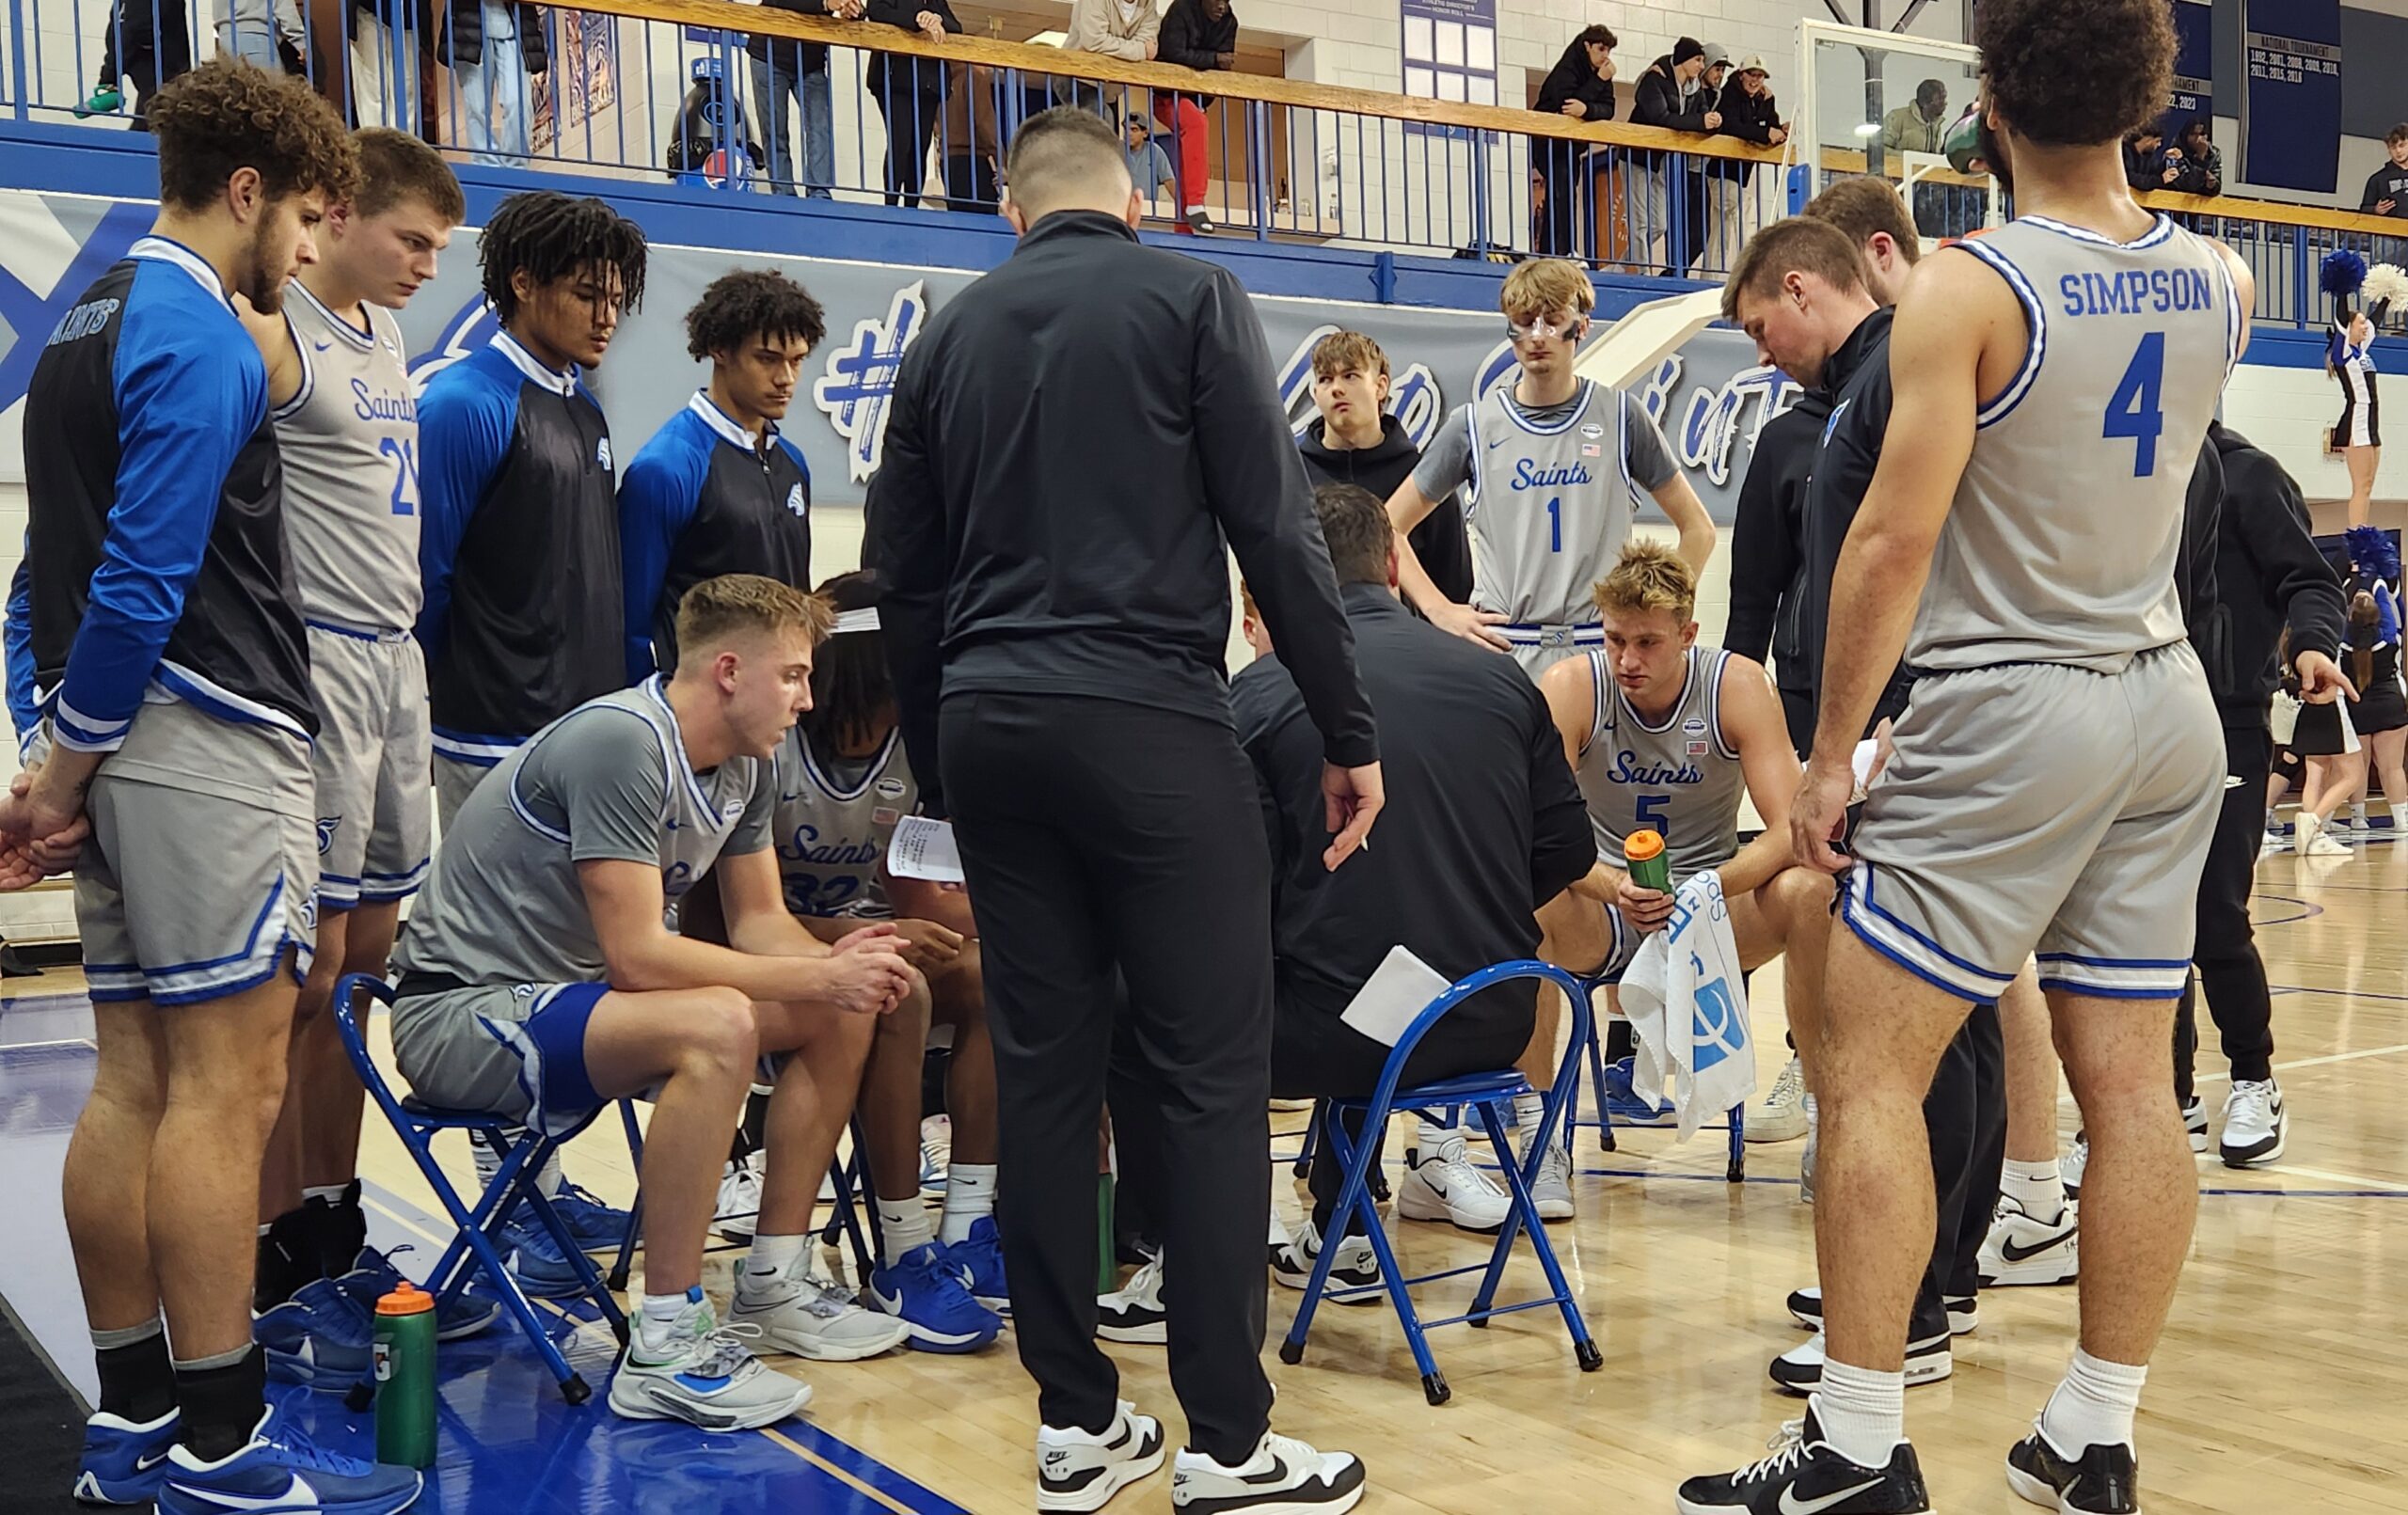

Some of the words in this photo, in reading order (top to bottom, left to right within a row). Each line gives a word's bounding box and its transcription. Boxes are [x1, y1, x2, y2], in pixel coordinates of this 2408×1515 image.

[2290, 40, 2330, 58] TOURNAMENT
[2059, 268, 2211, 317] SIMPSON
[351, 378, 418, 423] Saints
[2101, 332, 2165, 478] 4
[1511, 458, 1592, 491] Saints
[1546, 497, 1561, 553] 1
[1607, 750, 1703, 785] Saints
[1635, 795, 1671, 837] 5
[779, 824, 882, 864] Saints
